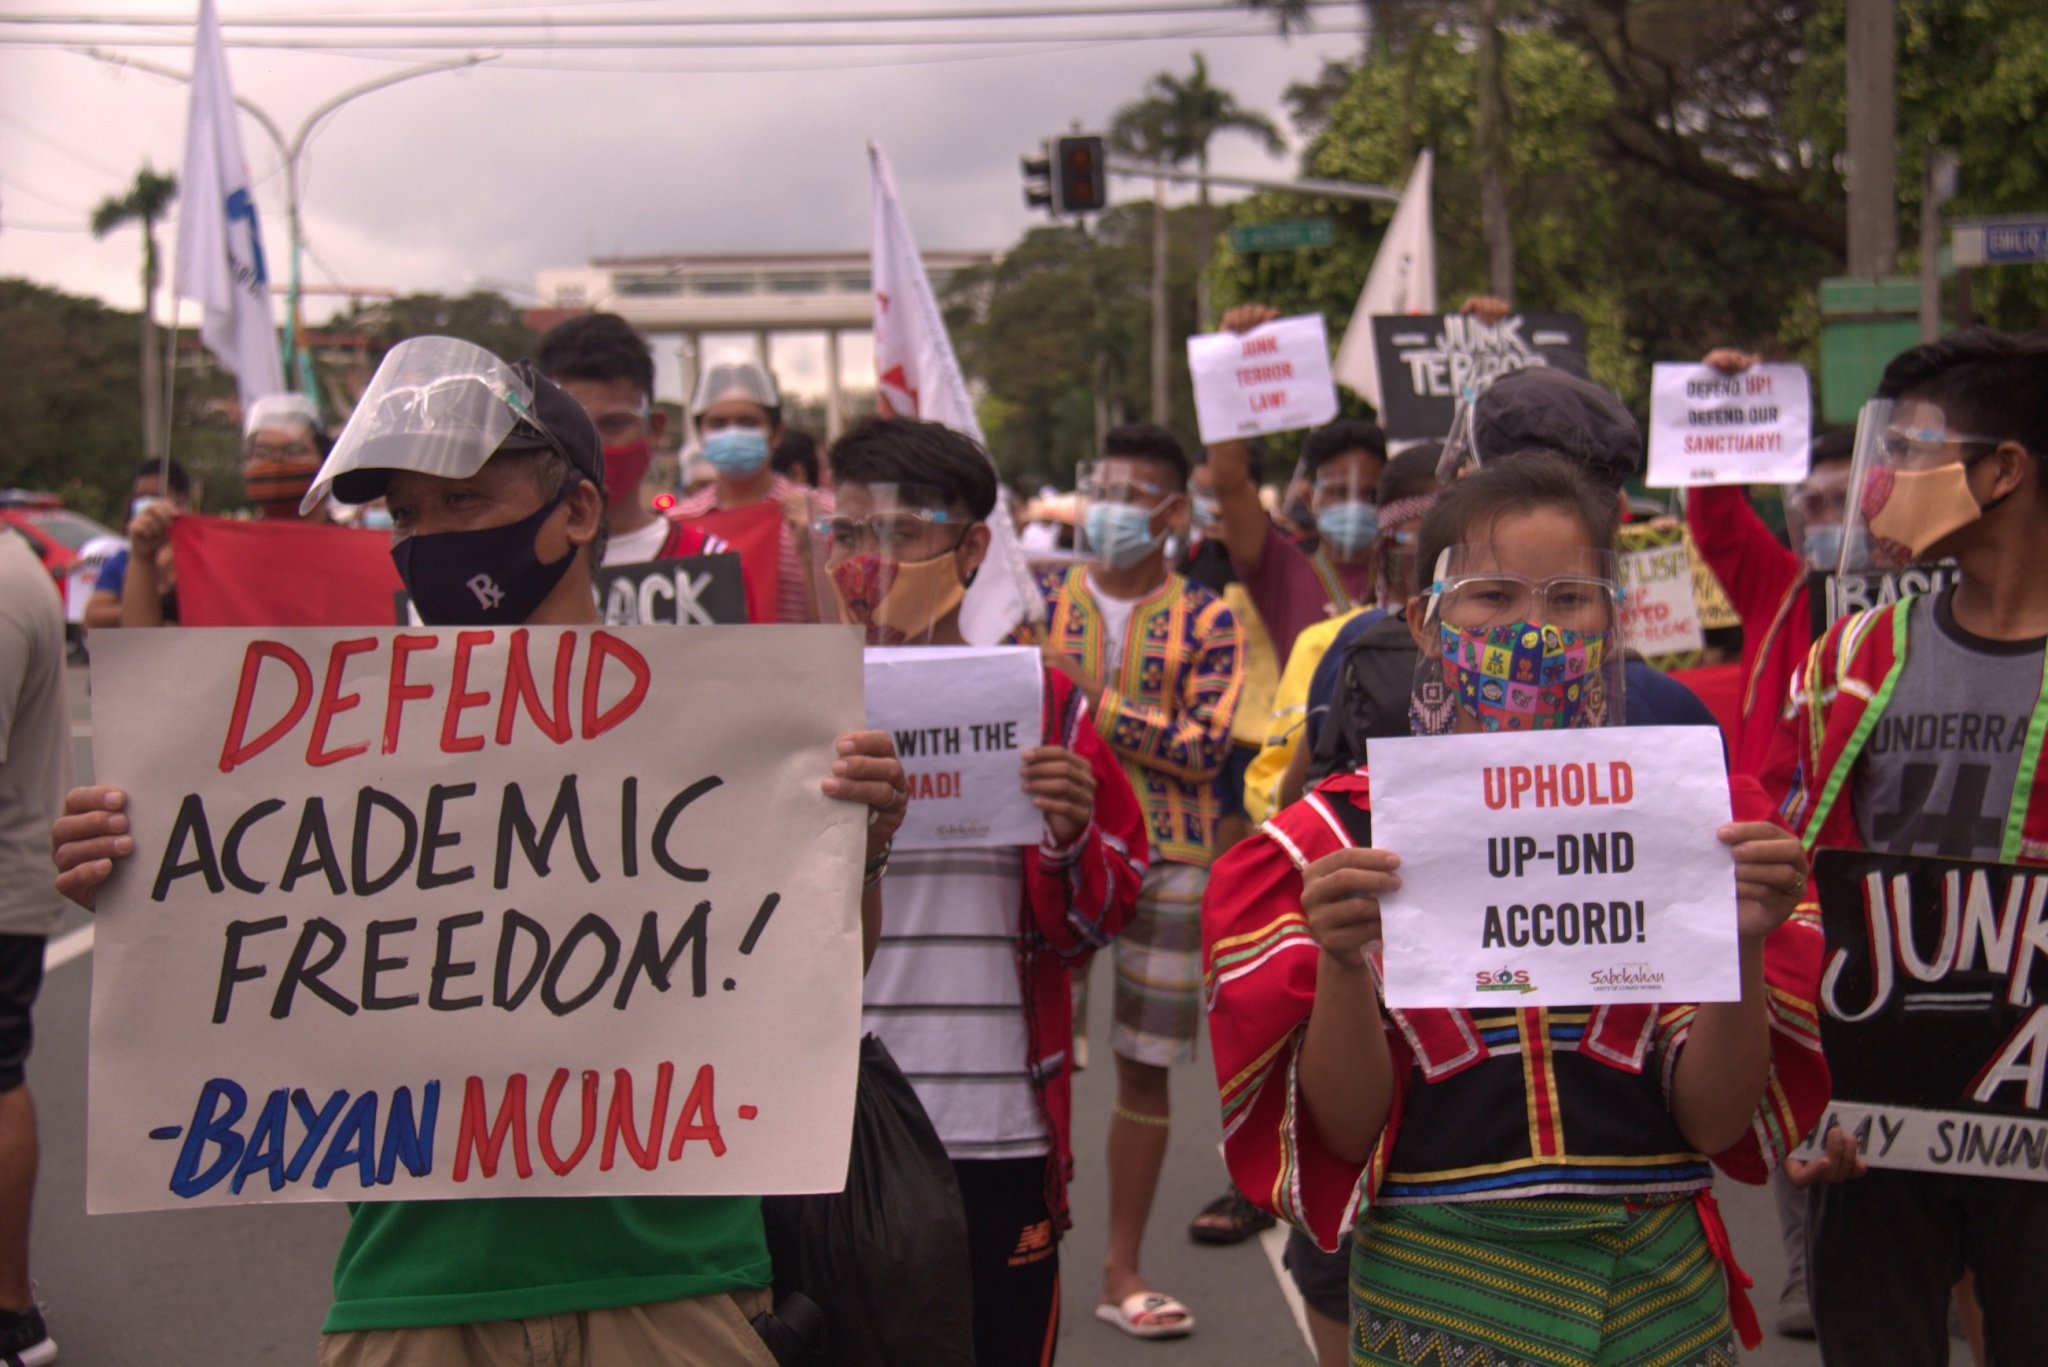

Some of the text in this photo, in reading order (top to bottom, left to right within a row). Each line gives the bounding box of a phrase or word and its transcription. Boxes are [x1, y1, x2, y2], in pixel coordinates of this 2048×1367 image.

[1242, 336, 1279, 358] JUNK
[1236, 361, 1293, 387] TERROR
[1745, 375, 1773, 396] UP!
[1688, 405, 1778, 426] DEFEND OUR
[1684, 432, 1782, 454] SANCTUARY!
[592, 568, 719, 626] ACK
[219, 628, 651, 772] DEFEND
[894, 720, 1018, 757] WITH THE
[1482, 761, 1634, 810] UPHOLD
[150, 774, 725, 902] ACADEMIC
[1487, 831, 1635, 878] UP-DND
[1481, 901, 1647, 949] ACCORD!
[1816, 868, 2048, 1022] JUNK
[211, 892, 781, 1024] FREEDOM!
[1589, 966, 1665, 985] Sabokahan
[1928, 1118, 2048, 1169] SININ
